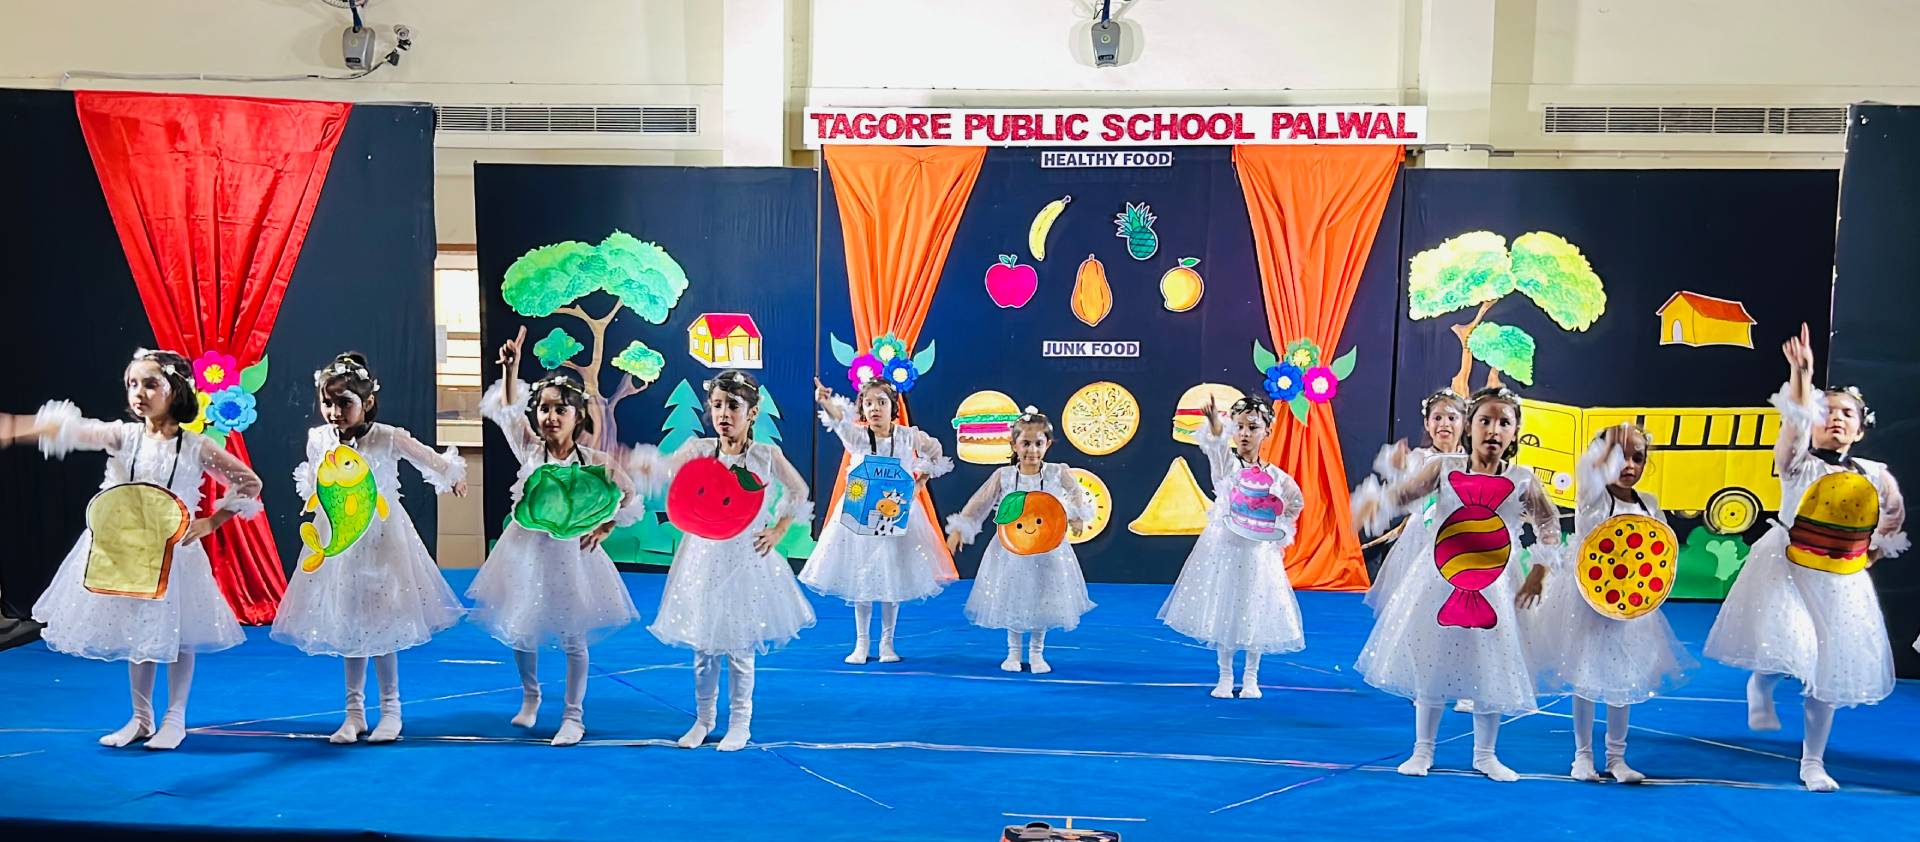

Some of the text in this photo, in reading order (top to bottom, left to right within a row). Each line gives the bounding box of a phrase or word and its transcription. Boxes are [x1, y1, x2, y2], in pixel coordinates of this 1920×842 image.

[810, 111, 1419, 142] TAGORE PUBLIC SCHOOL PALWAL
[1044, 153, 1170, 166] HEALTHY FOOD
[1044, 343, 1138, 355] JUNK FOOD
[873, 467, 902, 479] MILK
